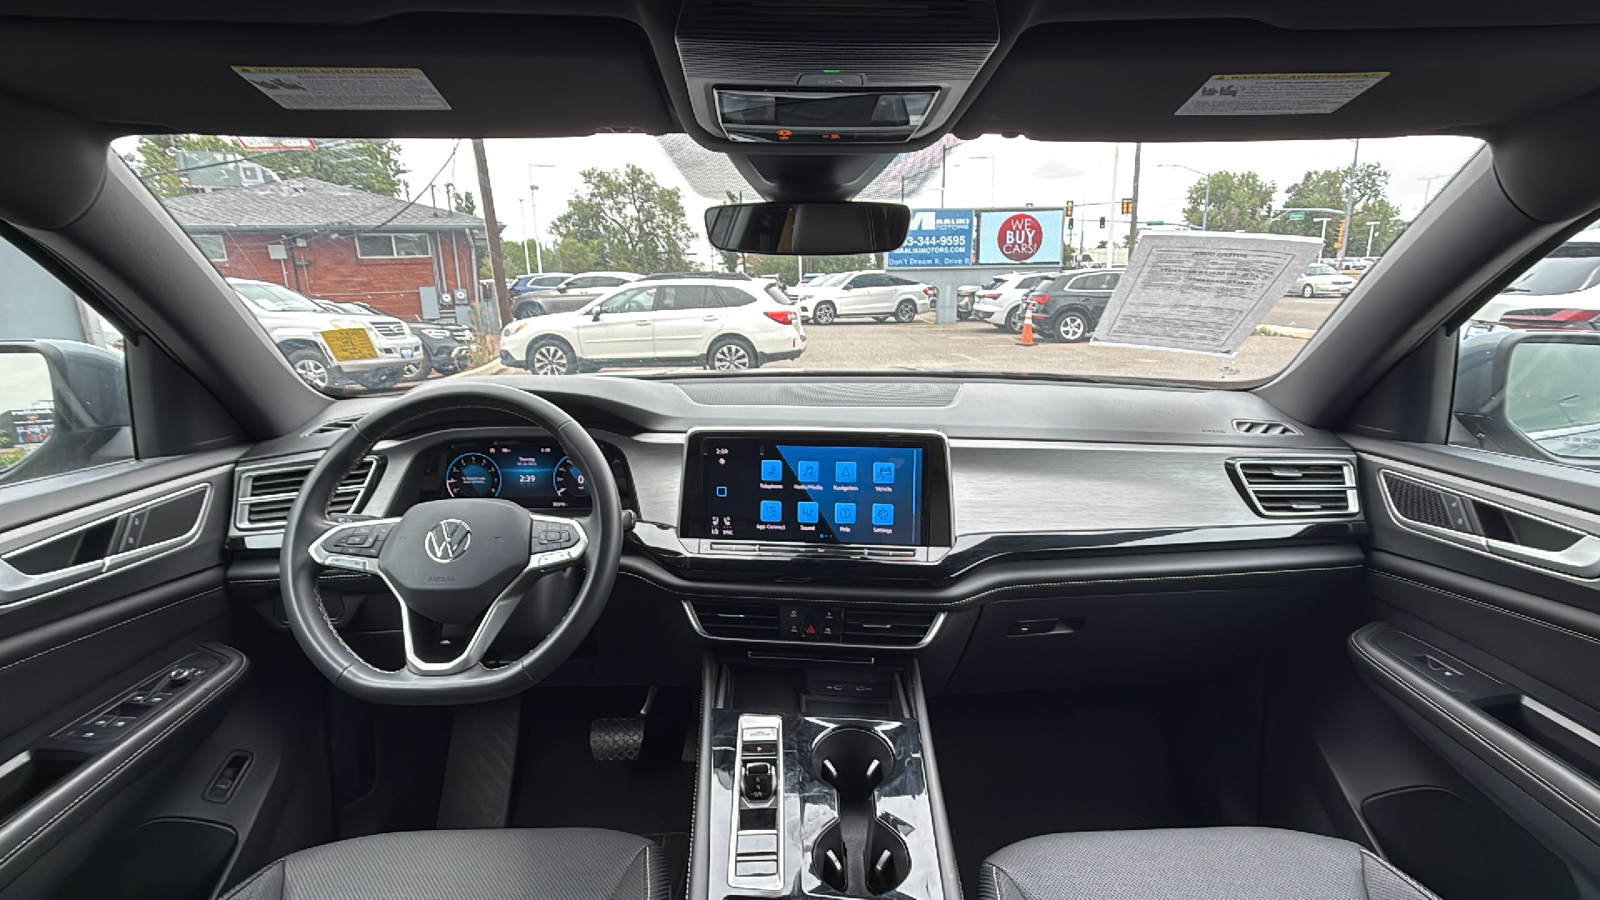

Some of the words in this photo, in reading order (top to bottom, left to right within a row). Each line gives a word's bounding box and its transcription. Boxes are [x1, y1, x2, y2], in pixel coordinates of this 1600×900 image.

[1011, 218, 1032, 231] WE
[902, 235, 966, 246] 3-344-9595
[1006, 230, 1035, 244] BUY
[1003, 243, 1037, 254] CARS!
[889, 258, 907, 266] Don't
[519, 474, 536, 483] 2:39
[577, 475, 585, 484] 0
[833, 484, 859, 492] Navigation
